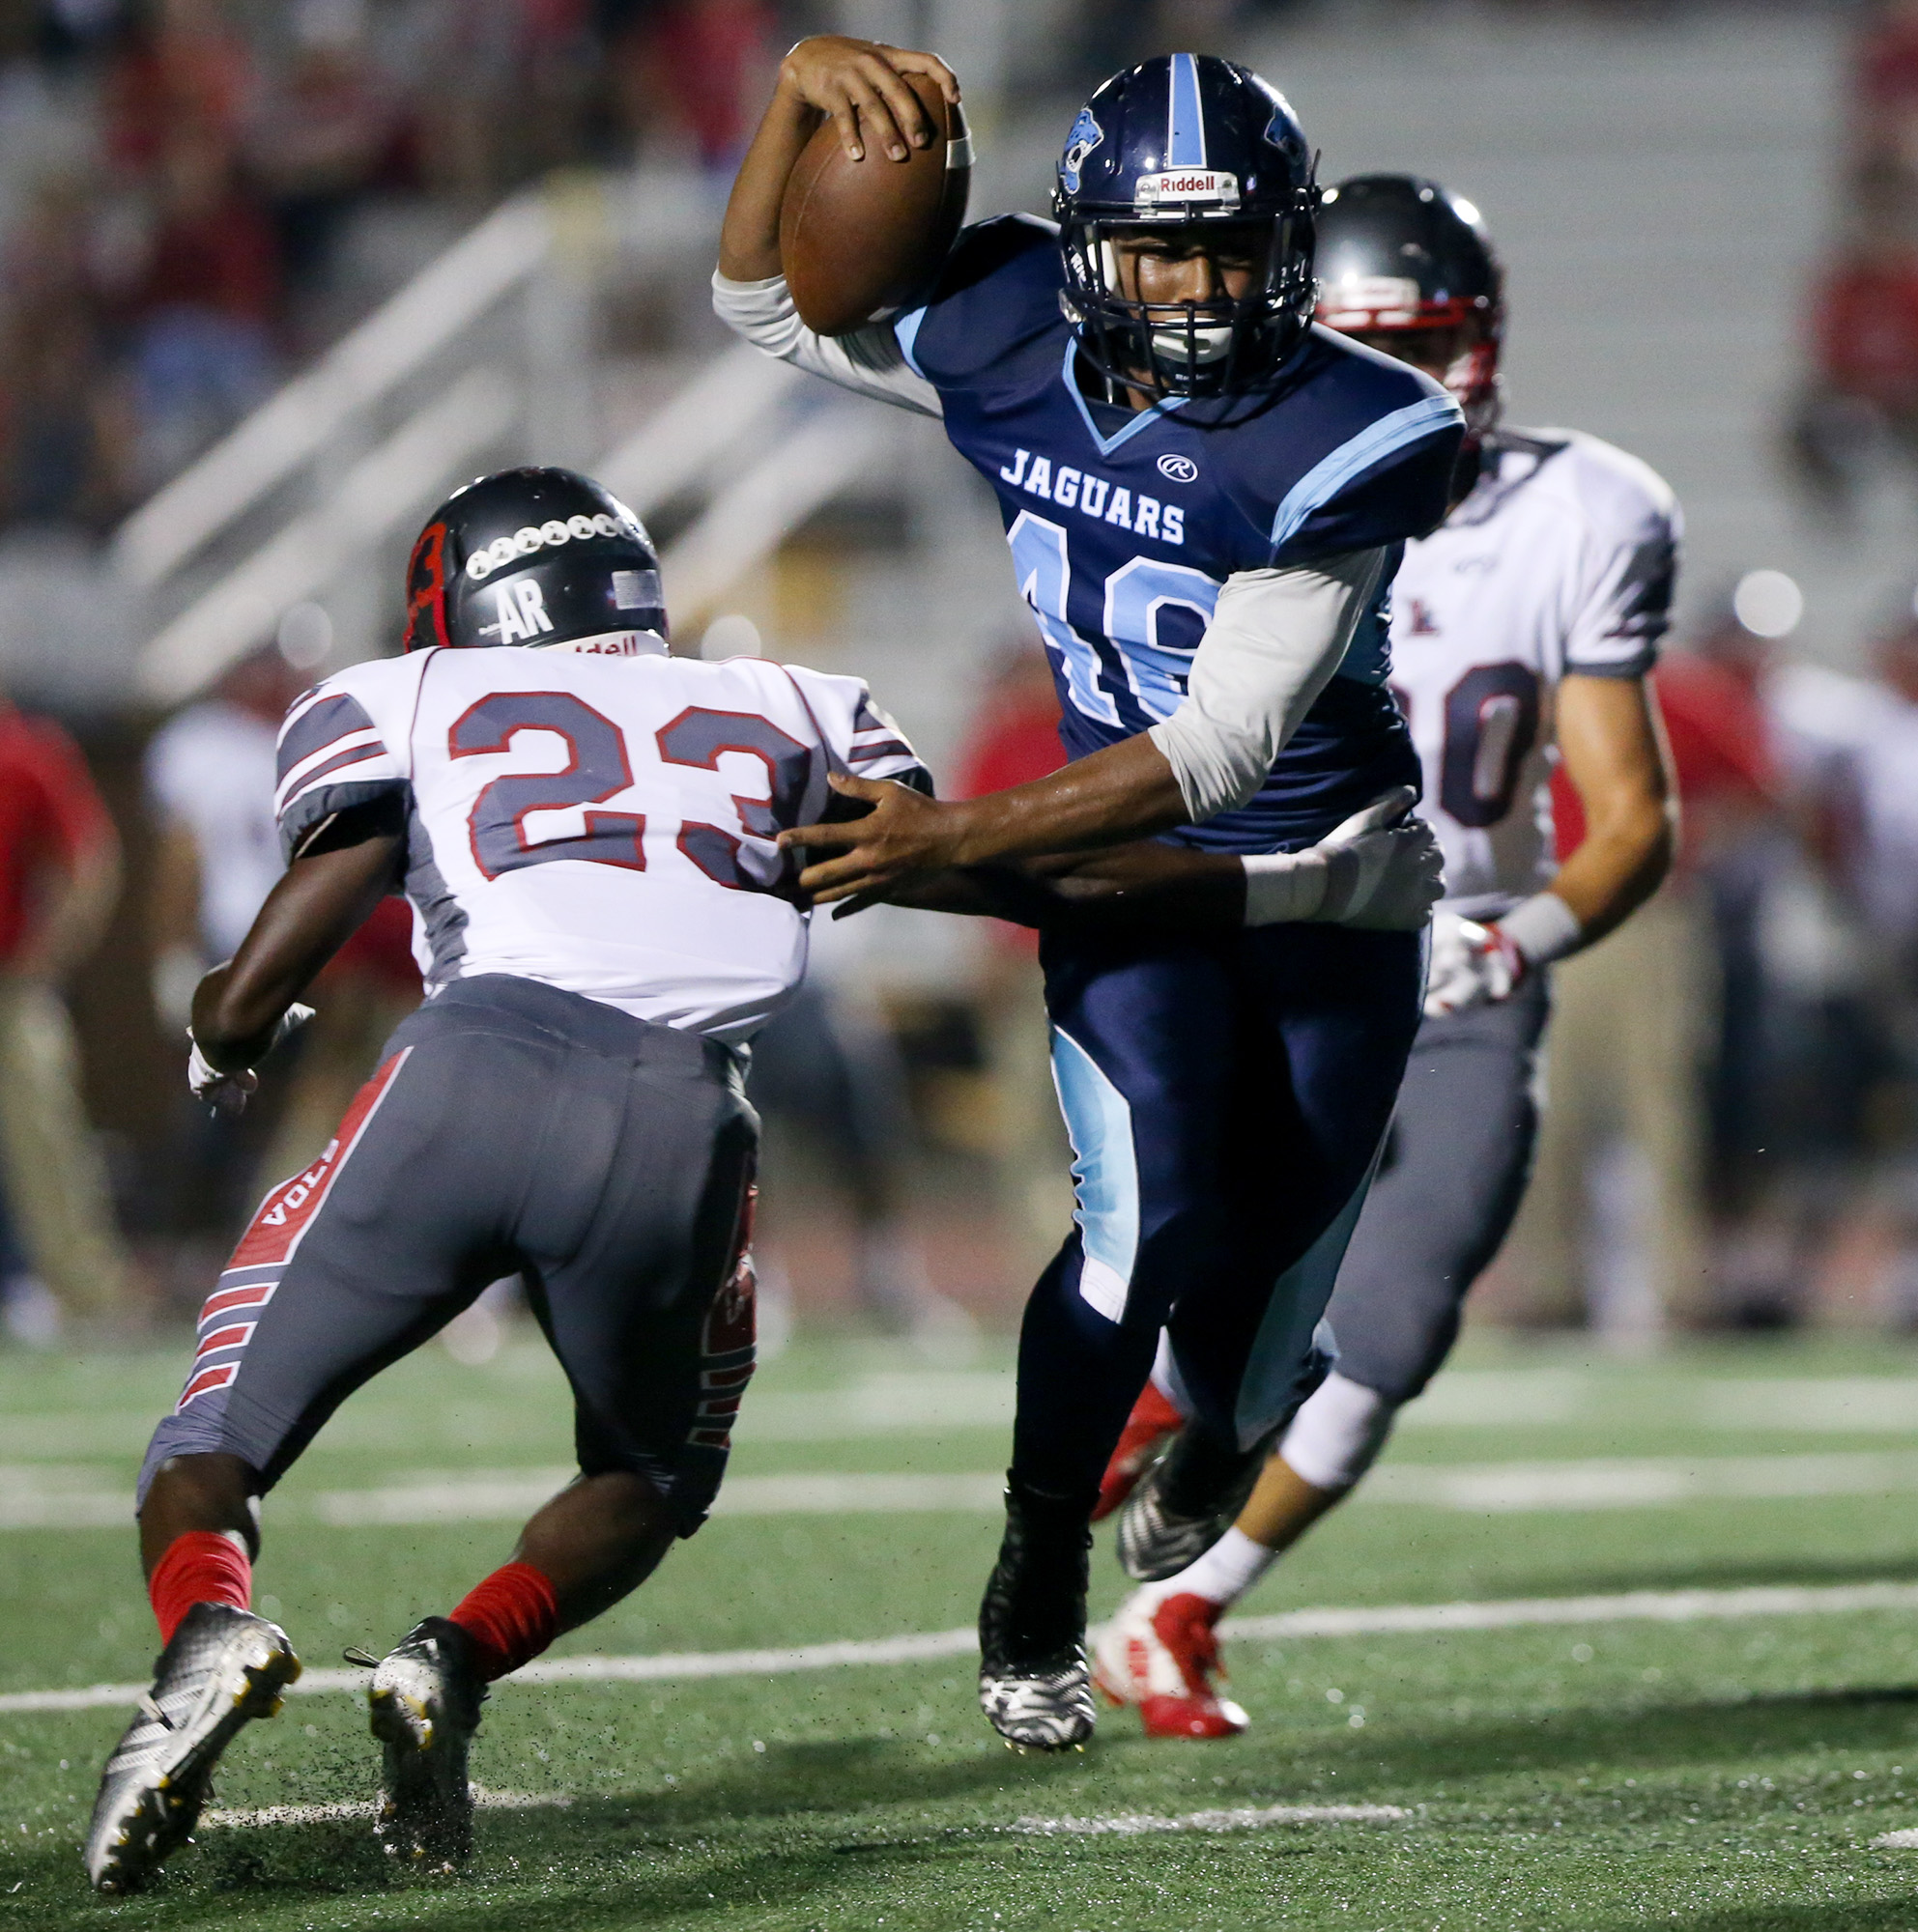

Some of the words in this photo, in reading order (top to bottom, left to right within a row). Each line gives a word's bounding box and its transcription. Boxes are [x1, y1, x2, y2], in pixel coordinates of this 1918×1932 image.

[1160, 176, 1215, 192] Riddell
[1000, 448, 1185, 546] JAGUARS
[496, 578, 555, 645] AR
[1006, 509, 1223, 728] 48
[448, 690, 812, 895] 23
